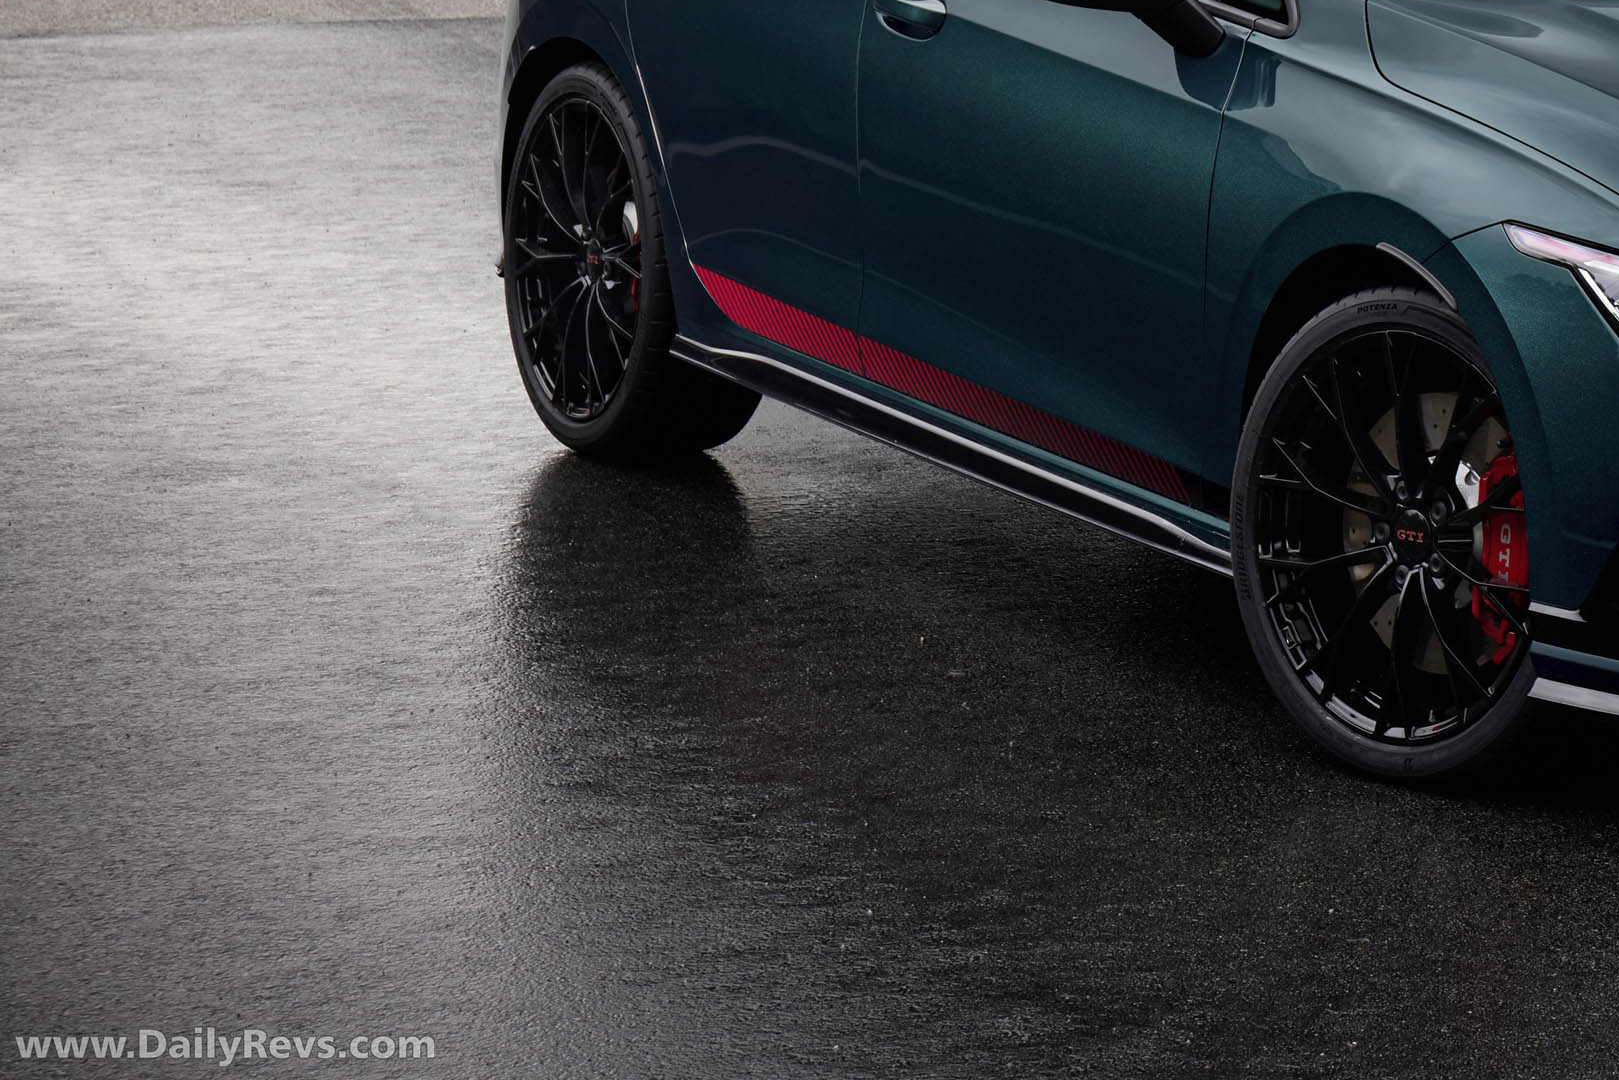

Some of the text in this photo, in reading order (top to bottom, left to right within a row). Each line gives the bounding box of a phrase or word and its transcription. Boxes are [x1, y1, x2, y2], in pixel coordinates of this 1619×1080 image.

[1356, 303, 1399, 314] POTENZA
[1395, 528, 1425, 544] GTI
[1497, 523, 1512, 584] GTI
